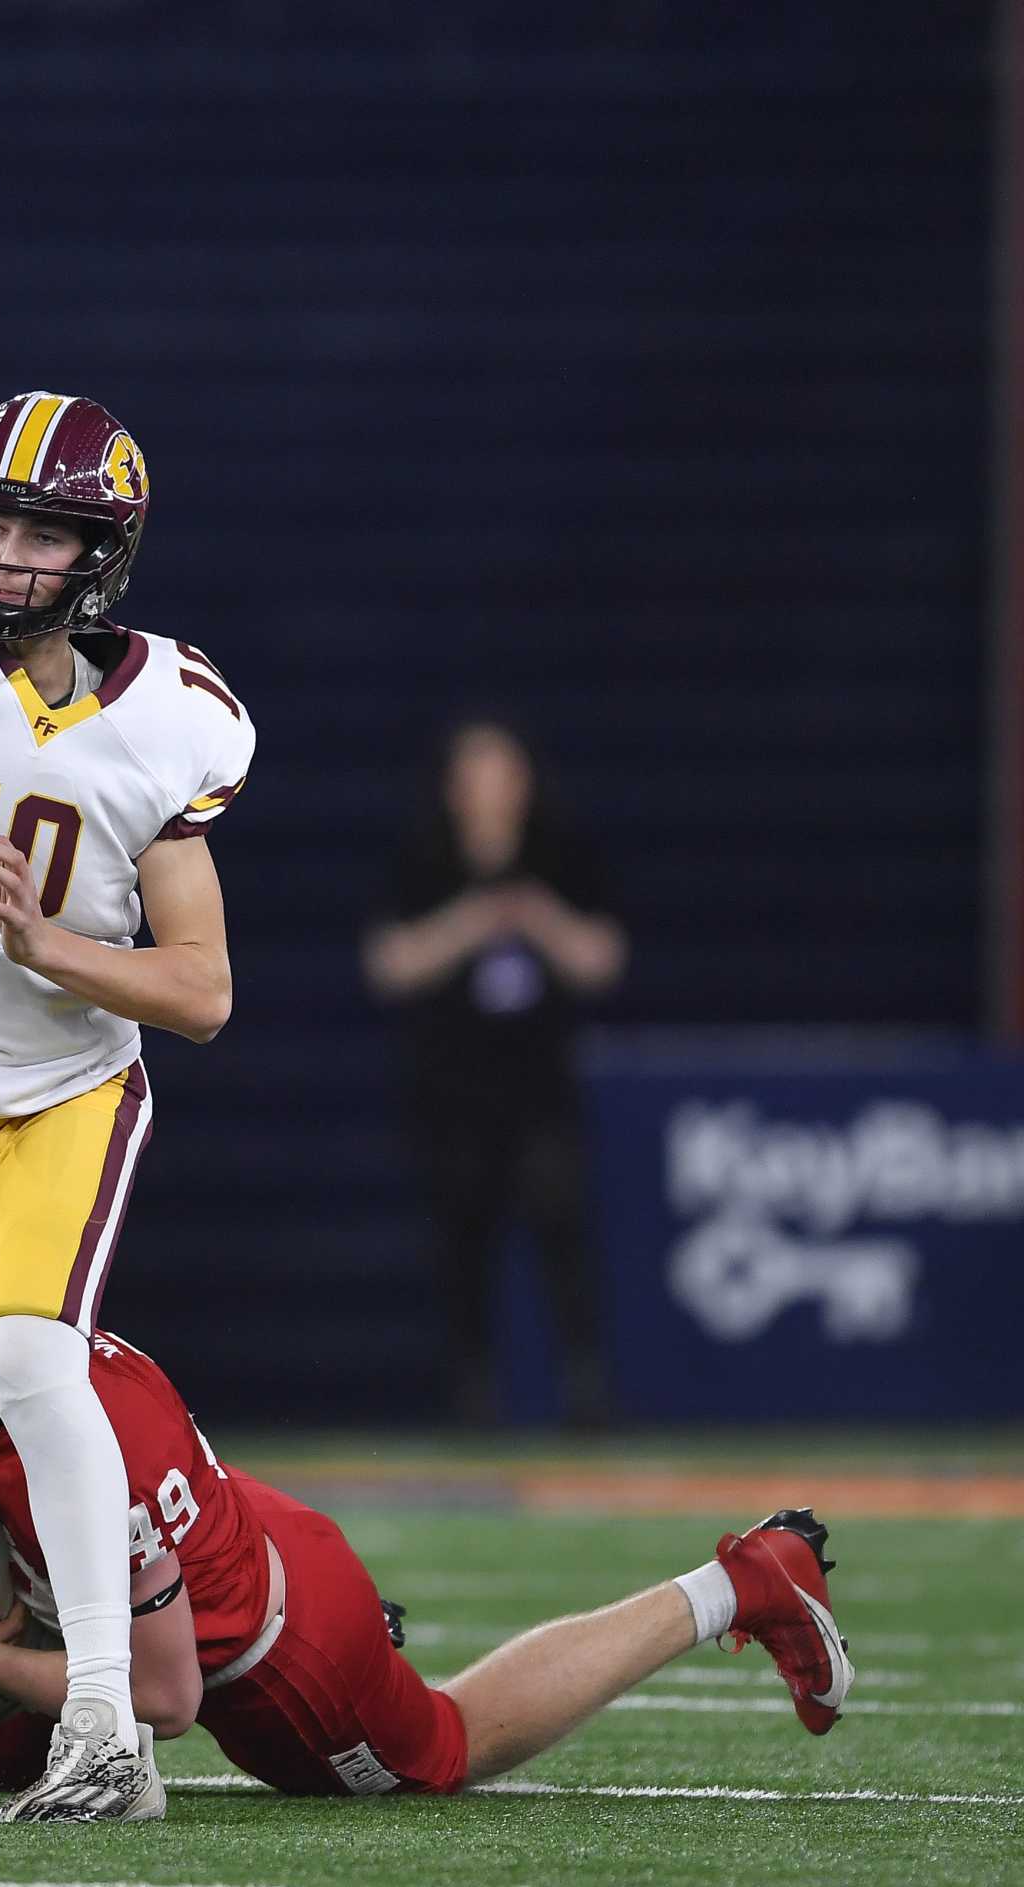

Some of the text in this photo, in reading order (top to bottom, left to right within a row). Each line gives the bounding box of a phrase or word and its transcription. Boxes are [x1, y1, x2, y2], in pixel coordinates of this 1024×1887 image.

[1, 483, 27, 494] VICIS
[34, 716, 58, 736] FF
[668, 1102, 1024, 1238] KeyBa
[129, 1467, 200, 1569] 49
